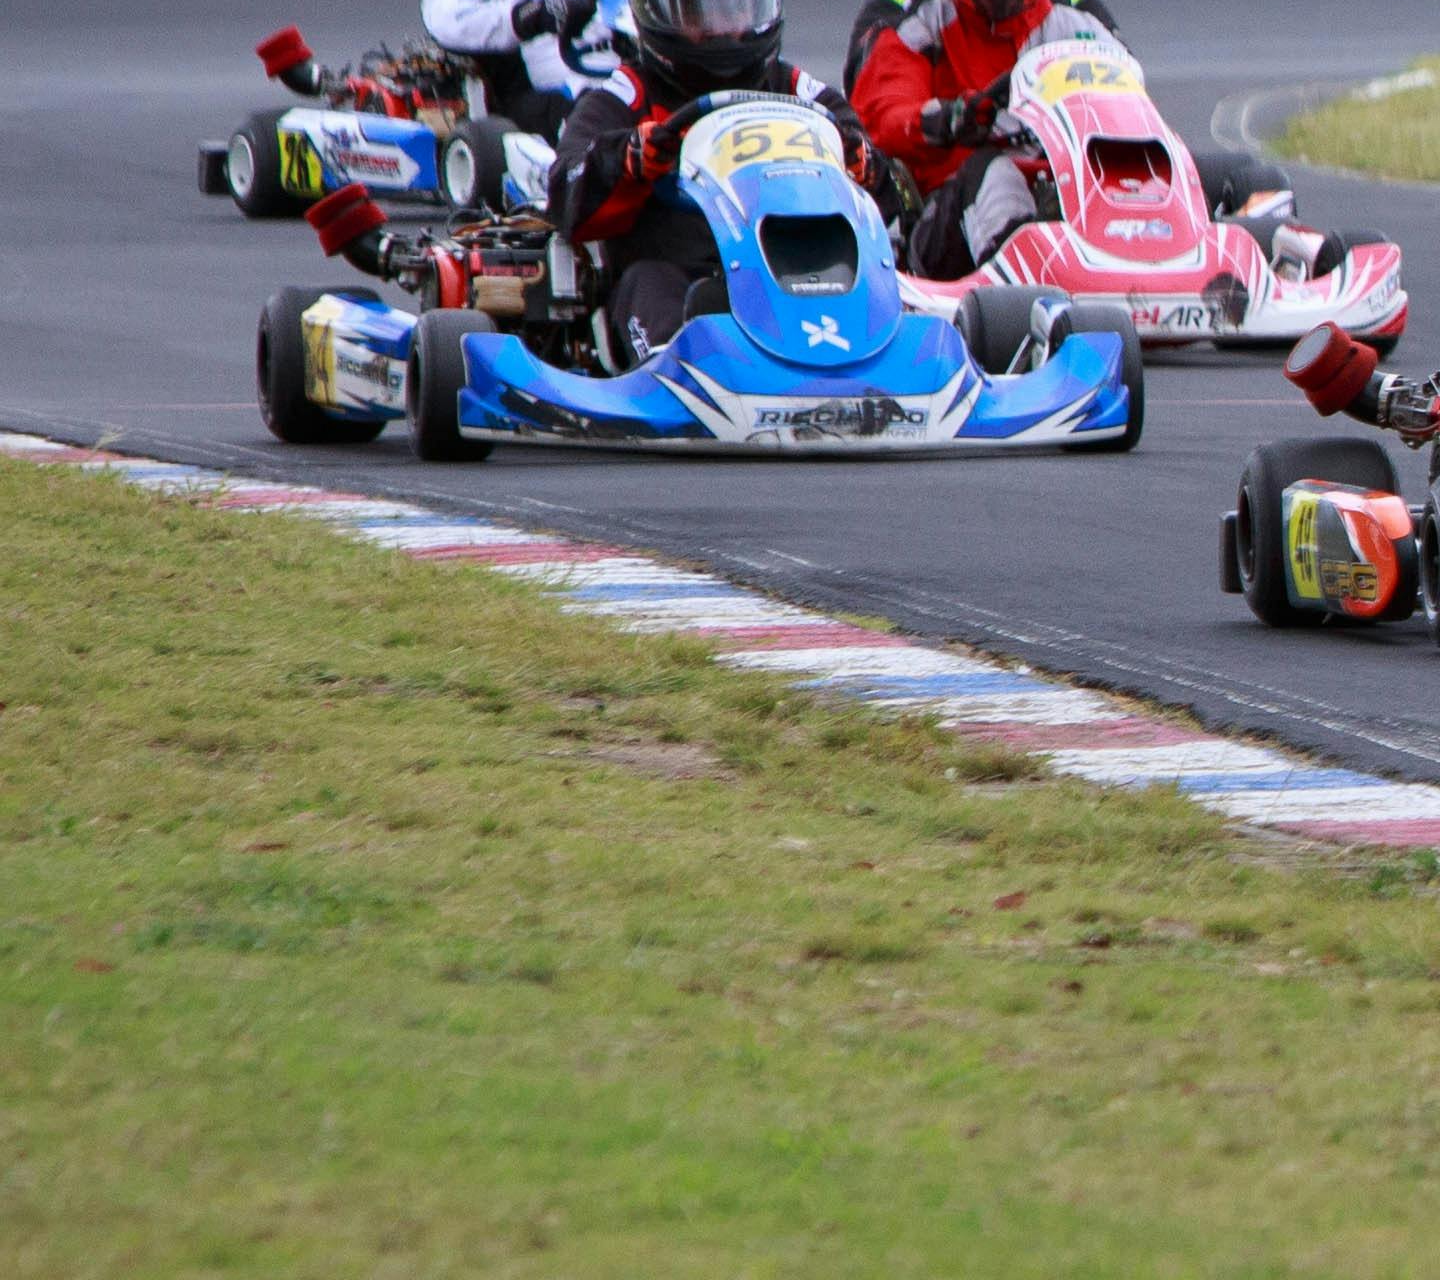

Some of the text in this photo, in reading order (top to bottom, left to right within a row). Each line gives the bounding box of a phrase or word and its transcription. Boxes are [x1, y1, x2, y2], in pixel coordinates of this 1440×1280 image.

[1064, 61, 1127, 87] 42
[732, 122, 825, 163] 54
[1319, 561, 1378, 602] CRG
